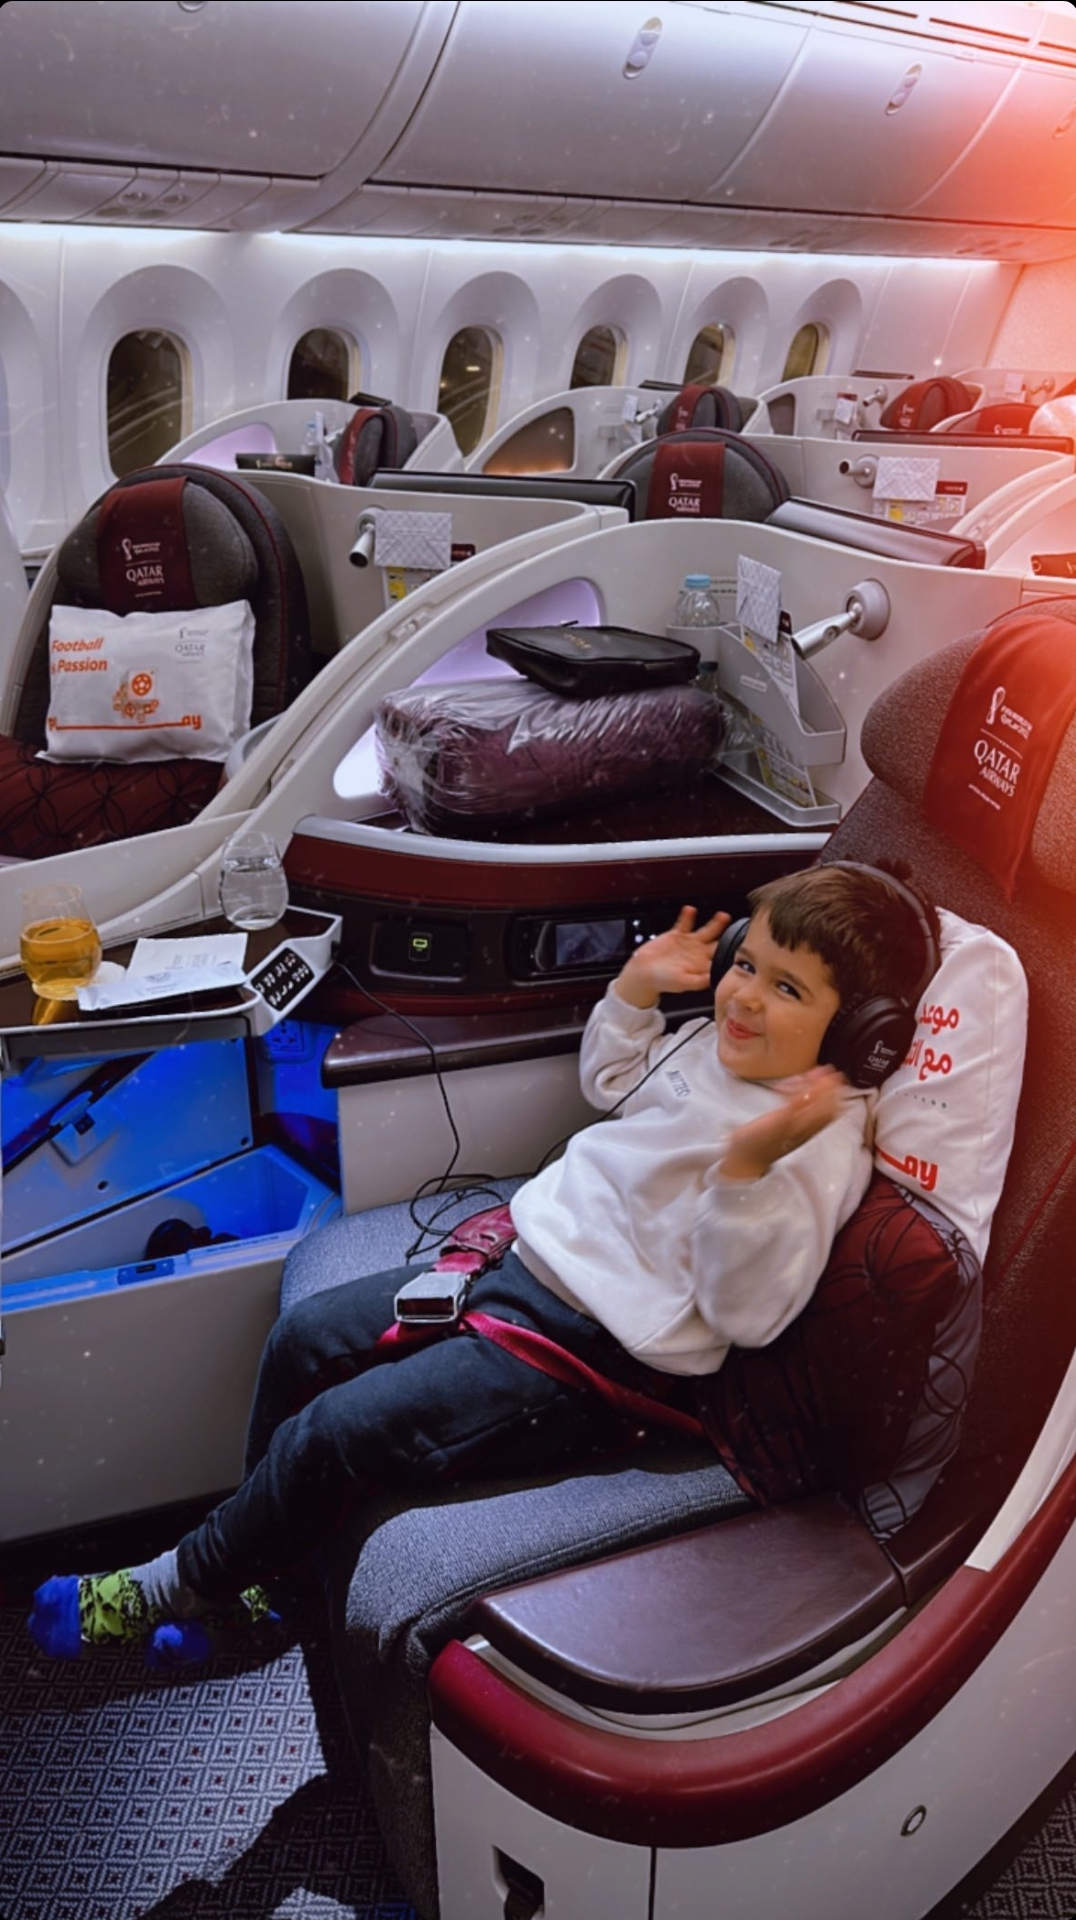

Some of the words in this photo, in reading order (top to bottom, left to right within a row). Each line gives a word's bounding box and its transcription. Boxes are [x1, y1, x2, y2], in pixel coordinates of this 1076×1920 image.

[126, 566, 163, 582] QATAR
[52, 636, 104, 652] Football
[57, 657, 108, 673] Passion
[974, 739, 1021, 785] QATAR
[979, 766, 1016, 798] AIRWAYS
